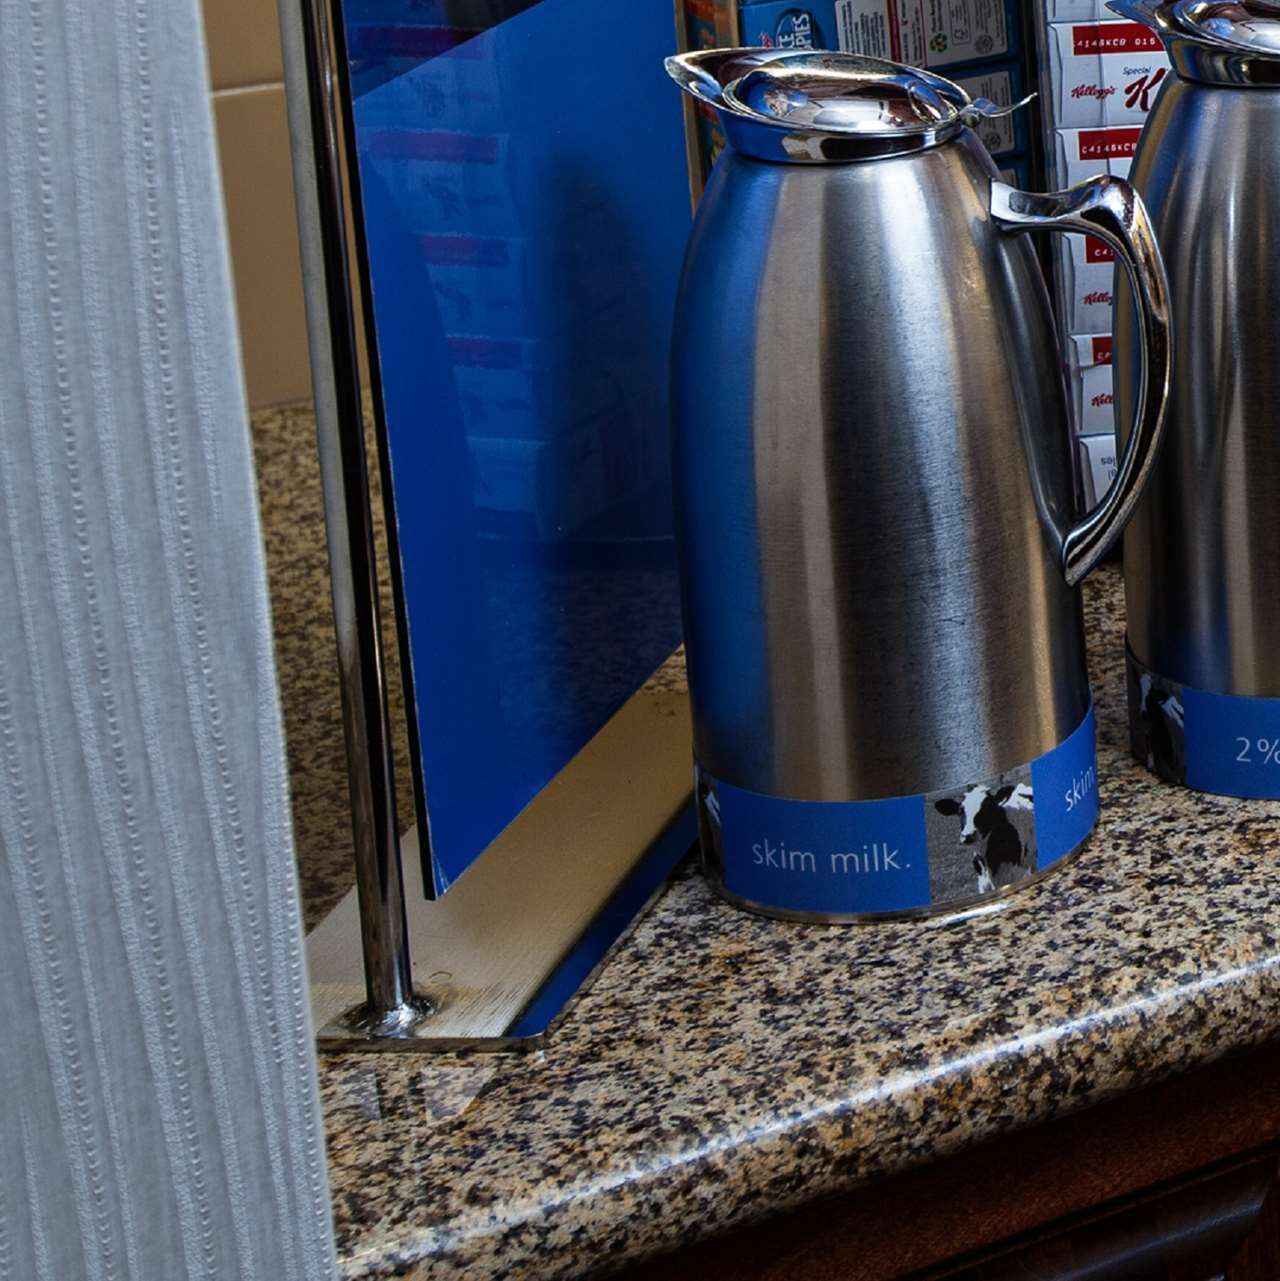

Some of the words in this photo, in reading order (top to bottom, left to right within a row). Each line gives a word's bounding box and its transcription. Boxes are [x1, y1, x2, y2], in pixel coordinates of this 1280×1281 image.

[779, 33, 795, 48] CE
[793, 13, 812, 49] PIES
[1122, 67, 1152, 75] Special
[1071, 84, 1117, 100] Kellogg's
[1124, 67, 1167, 112] K
[1083, 291, 1113, 305] Kello
[751, 839, 816, 873] skim
[831, 842, 911, 874] milk.
